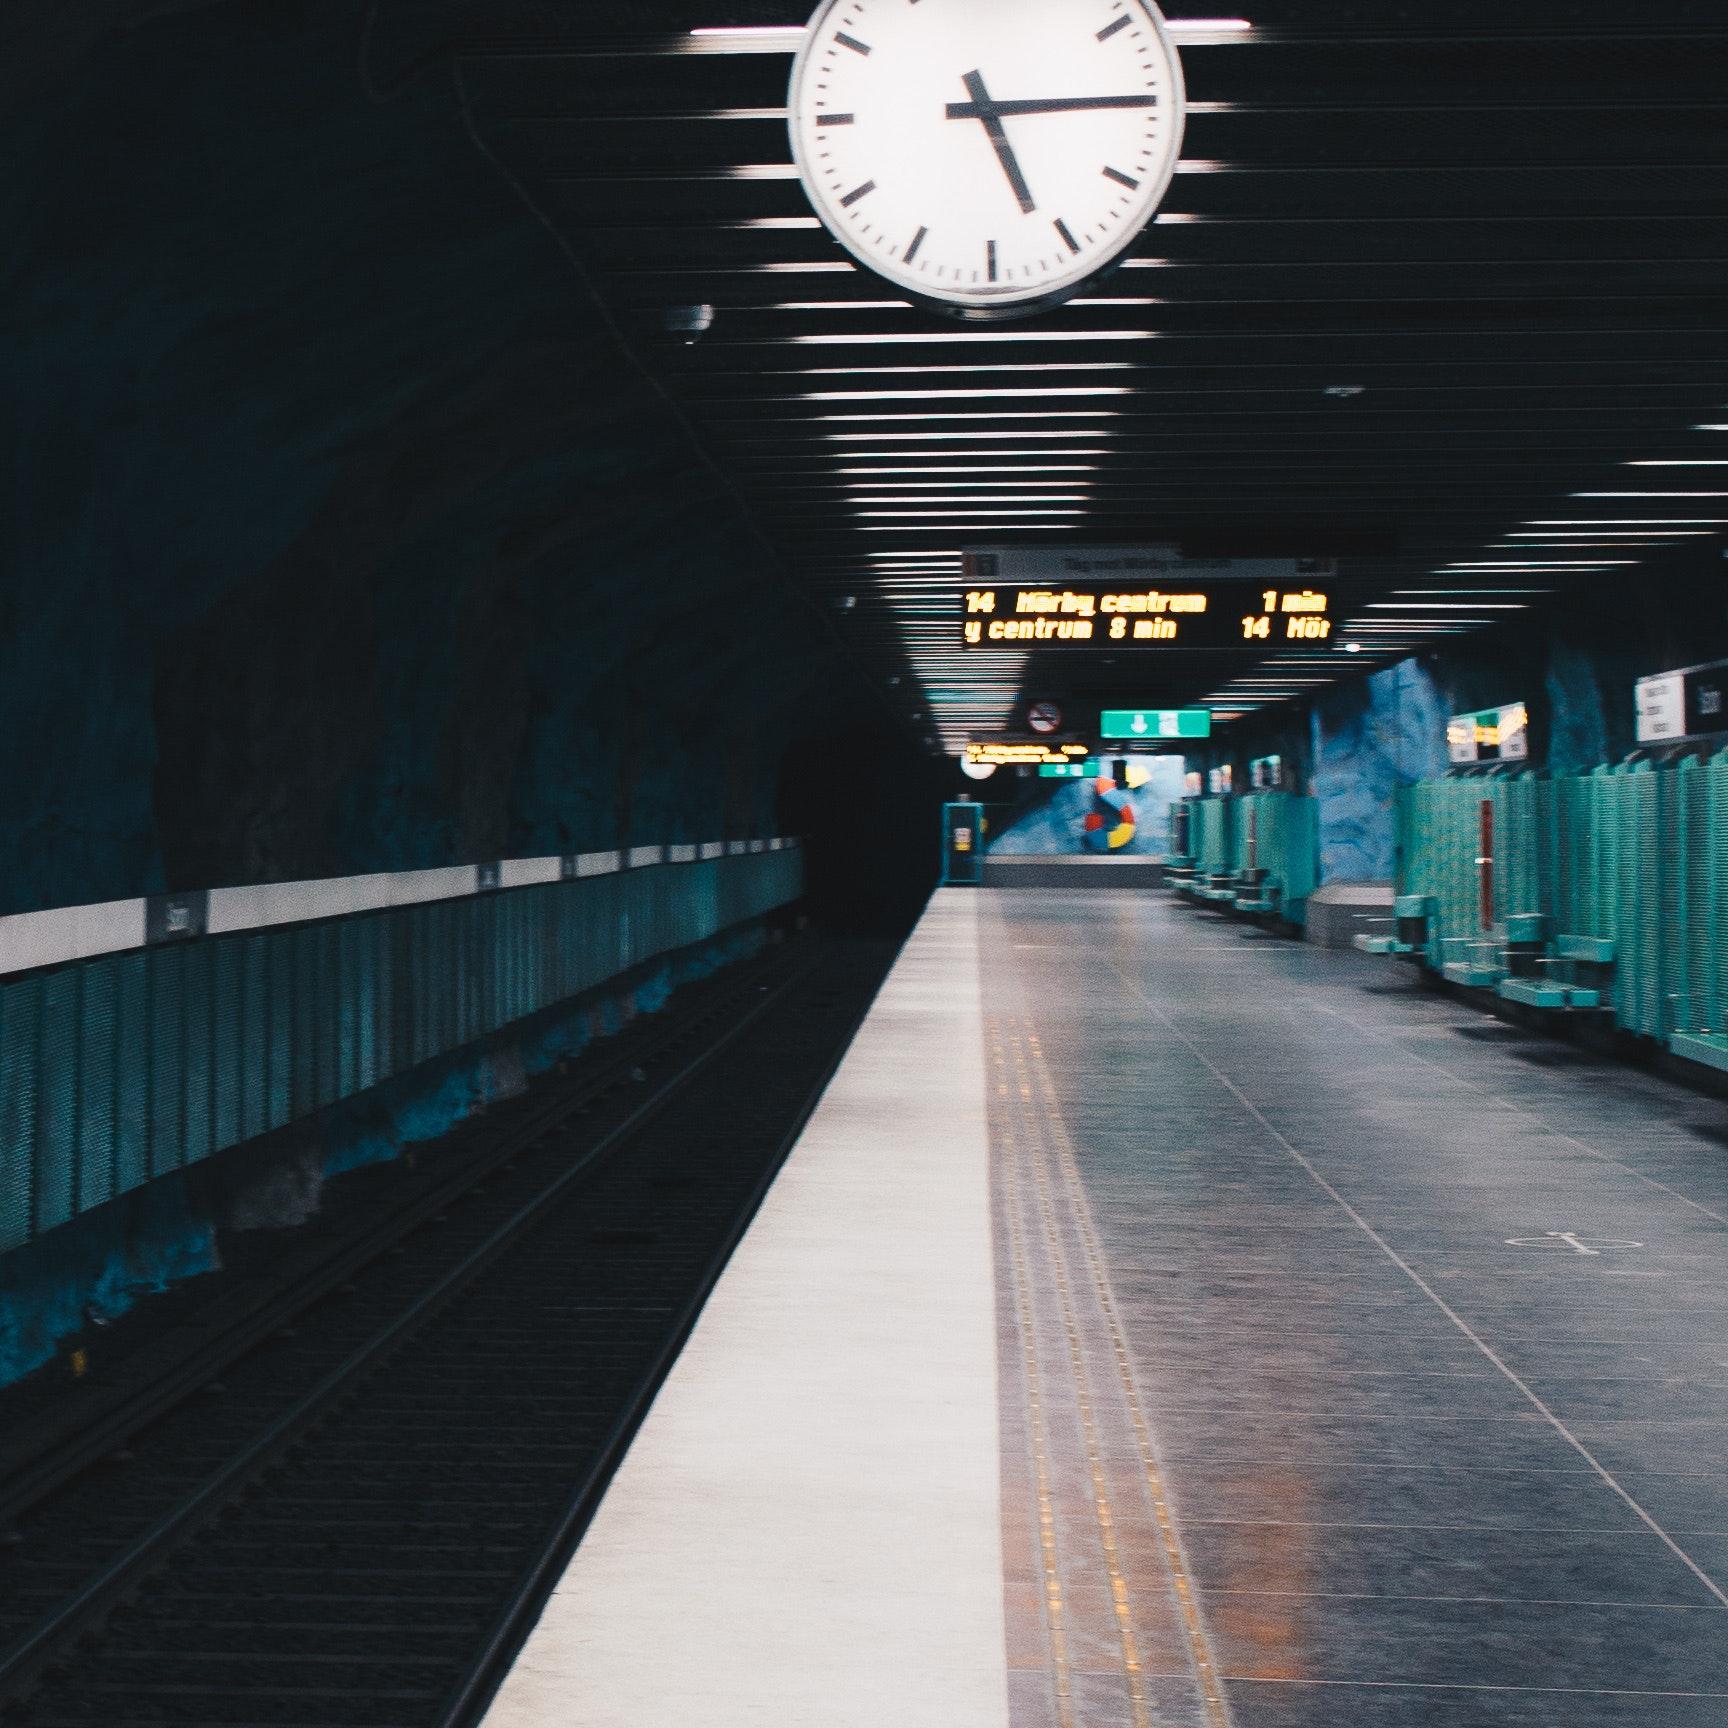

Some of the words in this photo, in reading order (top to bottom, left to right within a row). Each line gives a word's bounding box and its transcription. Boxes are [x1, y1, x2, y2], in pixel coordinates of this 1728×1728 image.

[965, 591, 995, 613] 14
[1099, 591, 1207, 613] centrum
[1262, 590, 1277, 613] 1
[1281, 590, 1327, 613] min
[988, 617, 1093, 639] centrum
[1108, 616, 1127, 639] 8
[1133, 616, 1177, 639] min
[1241, 616, 1271, 639] 14
